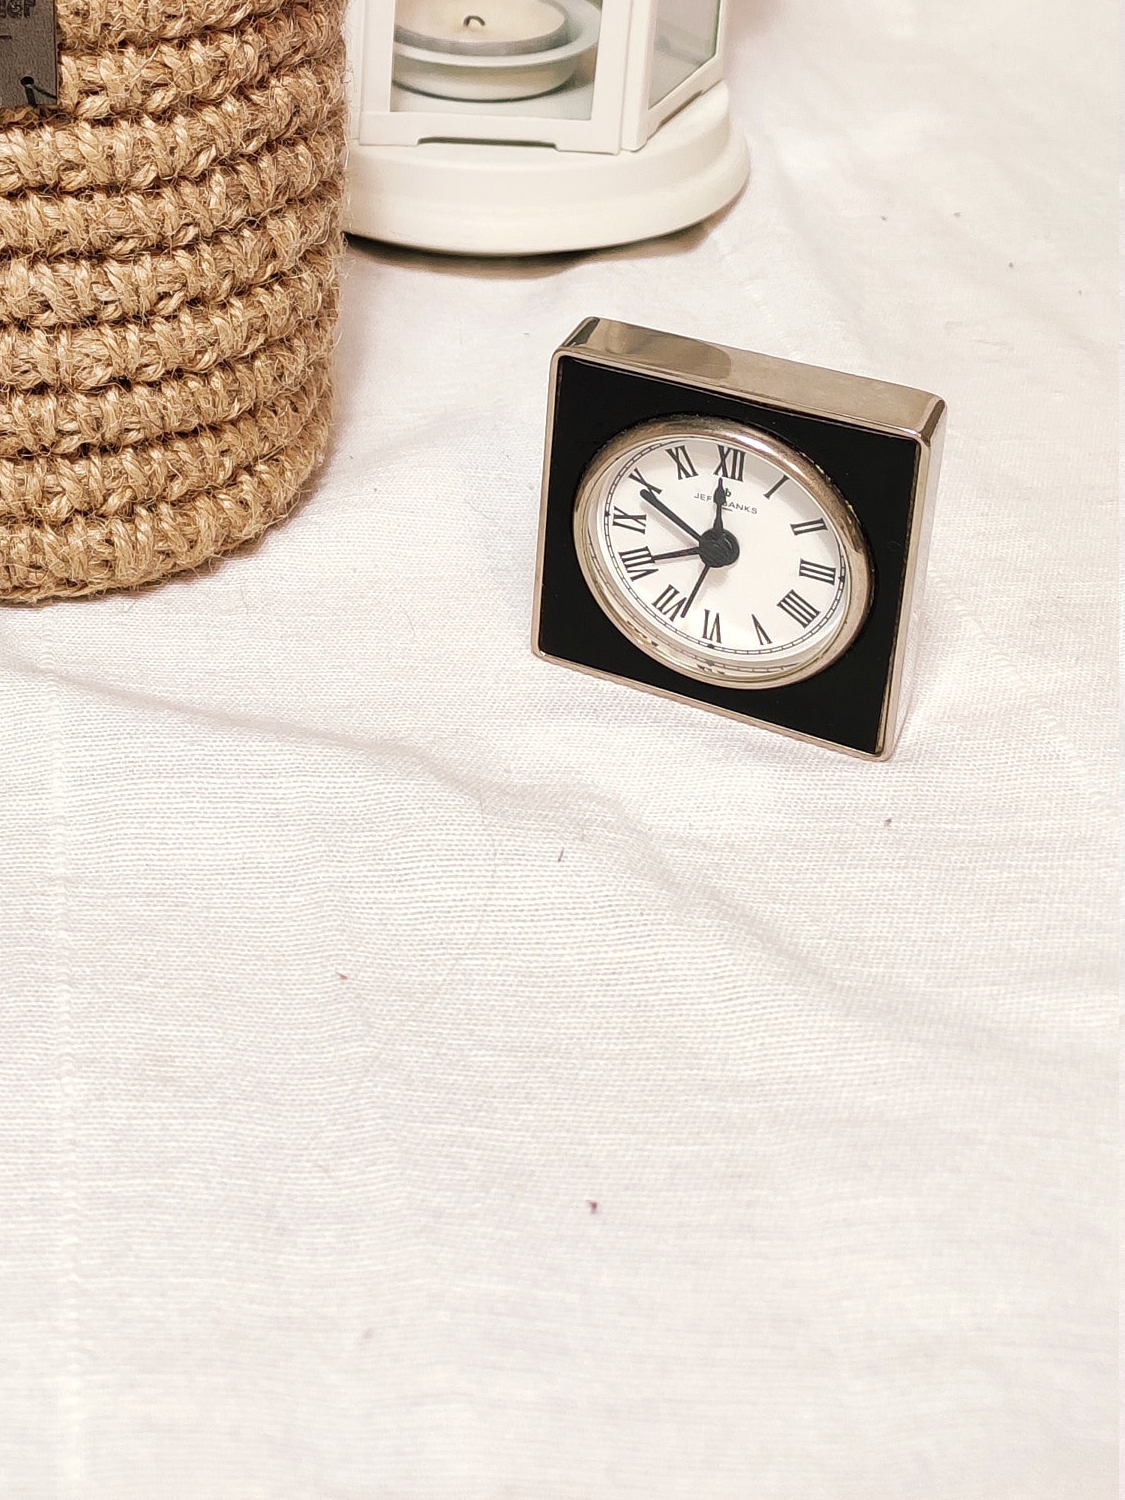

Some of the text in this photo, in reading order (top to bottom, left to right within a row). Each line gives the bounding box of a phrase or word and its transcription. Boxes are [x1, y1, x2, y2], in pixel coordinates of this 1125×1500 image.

[665, 445, 699, 480] XI
[713, 444, 746, 482] XII
[628, 468, 662, 498] X
[694, 493, 715, 502] JEF
[763, 475, 789, 499] I
[612, 505, 646, 534] IX
[790, 518, 828, 535] II
[618, 545, 659, 582] VIII
[799, 558, 836, 586] III
[651, 584, 687, 622] VII
[702, 609, 722, 644] VI
[751, 614, 772, 645] V
